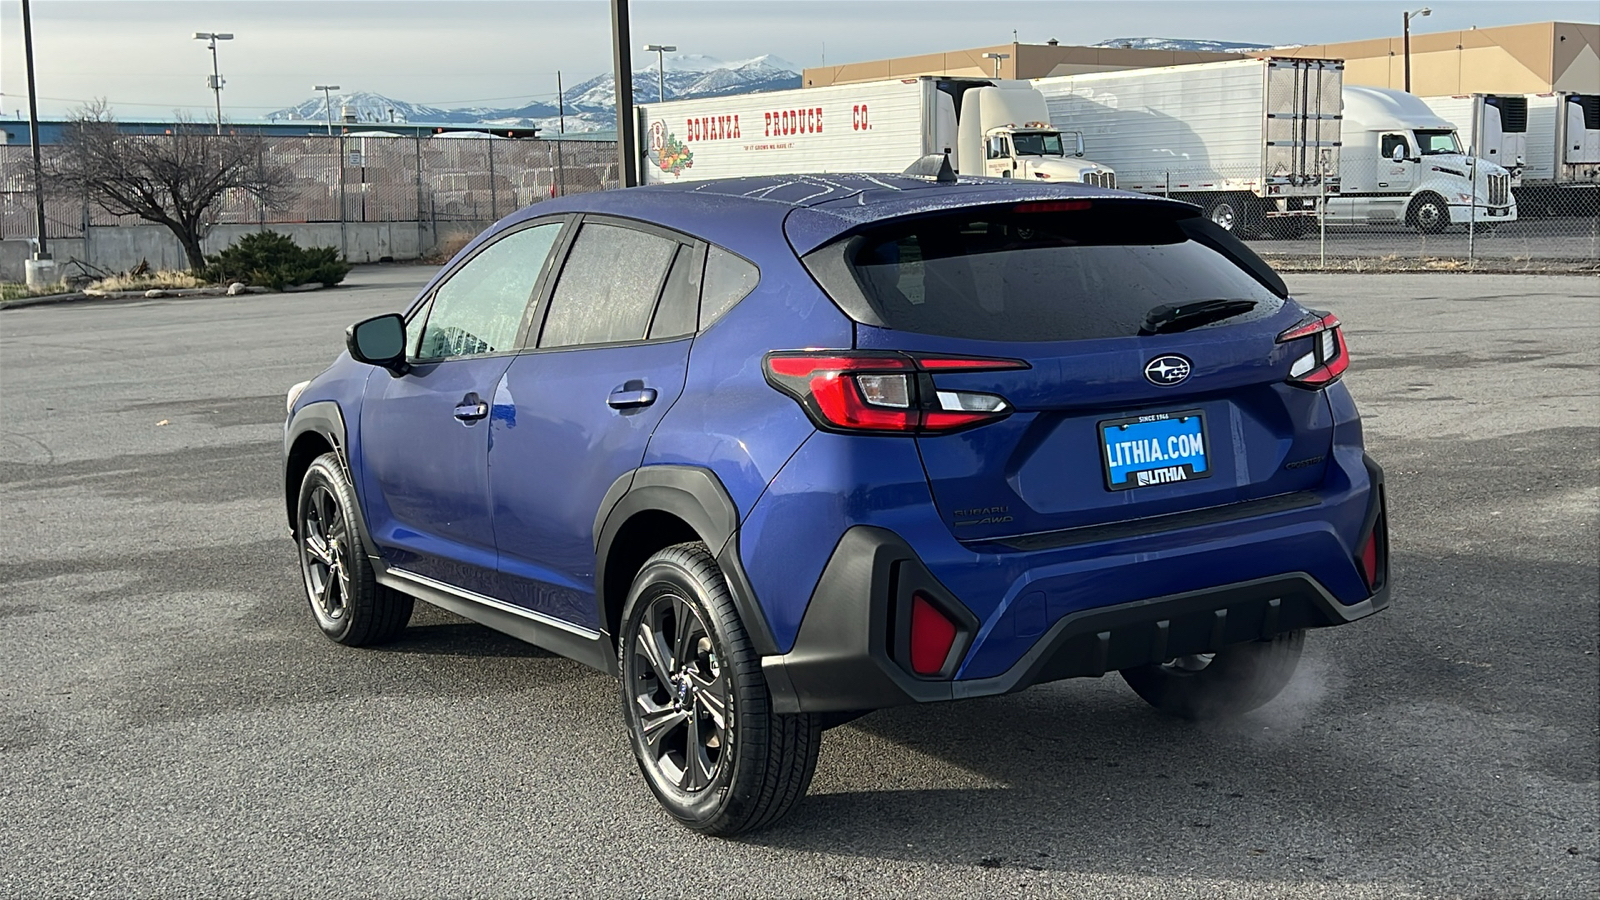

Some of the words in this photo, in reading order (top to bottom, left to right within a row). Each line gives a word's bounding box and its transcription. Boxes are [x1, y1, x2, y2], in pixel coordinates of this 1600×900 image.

[687, 114, 741, 142] BONANZA
[765, 107, 823, 137] PRODUCE
[853, 104, 872, 131] CO.
[1138, 414, 1156, 423] SINCE
[1106, 432, 1204, 468] LITHIA.COM
[1148, 466, 1187, 485] LITHIA
[954, 506, 1009, 517] SUBARU
[976, 515, 1014, 525] AWD
